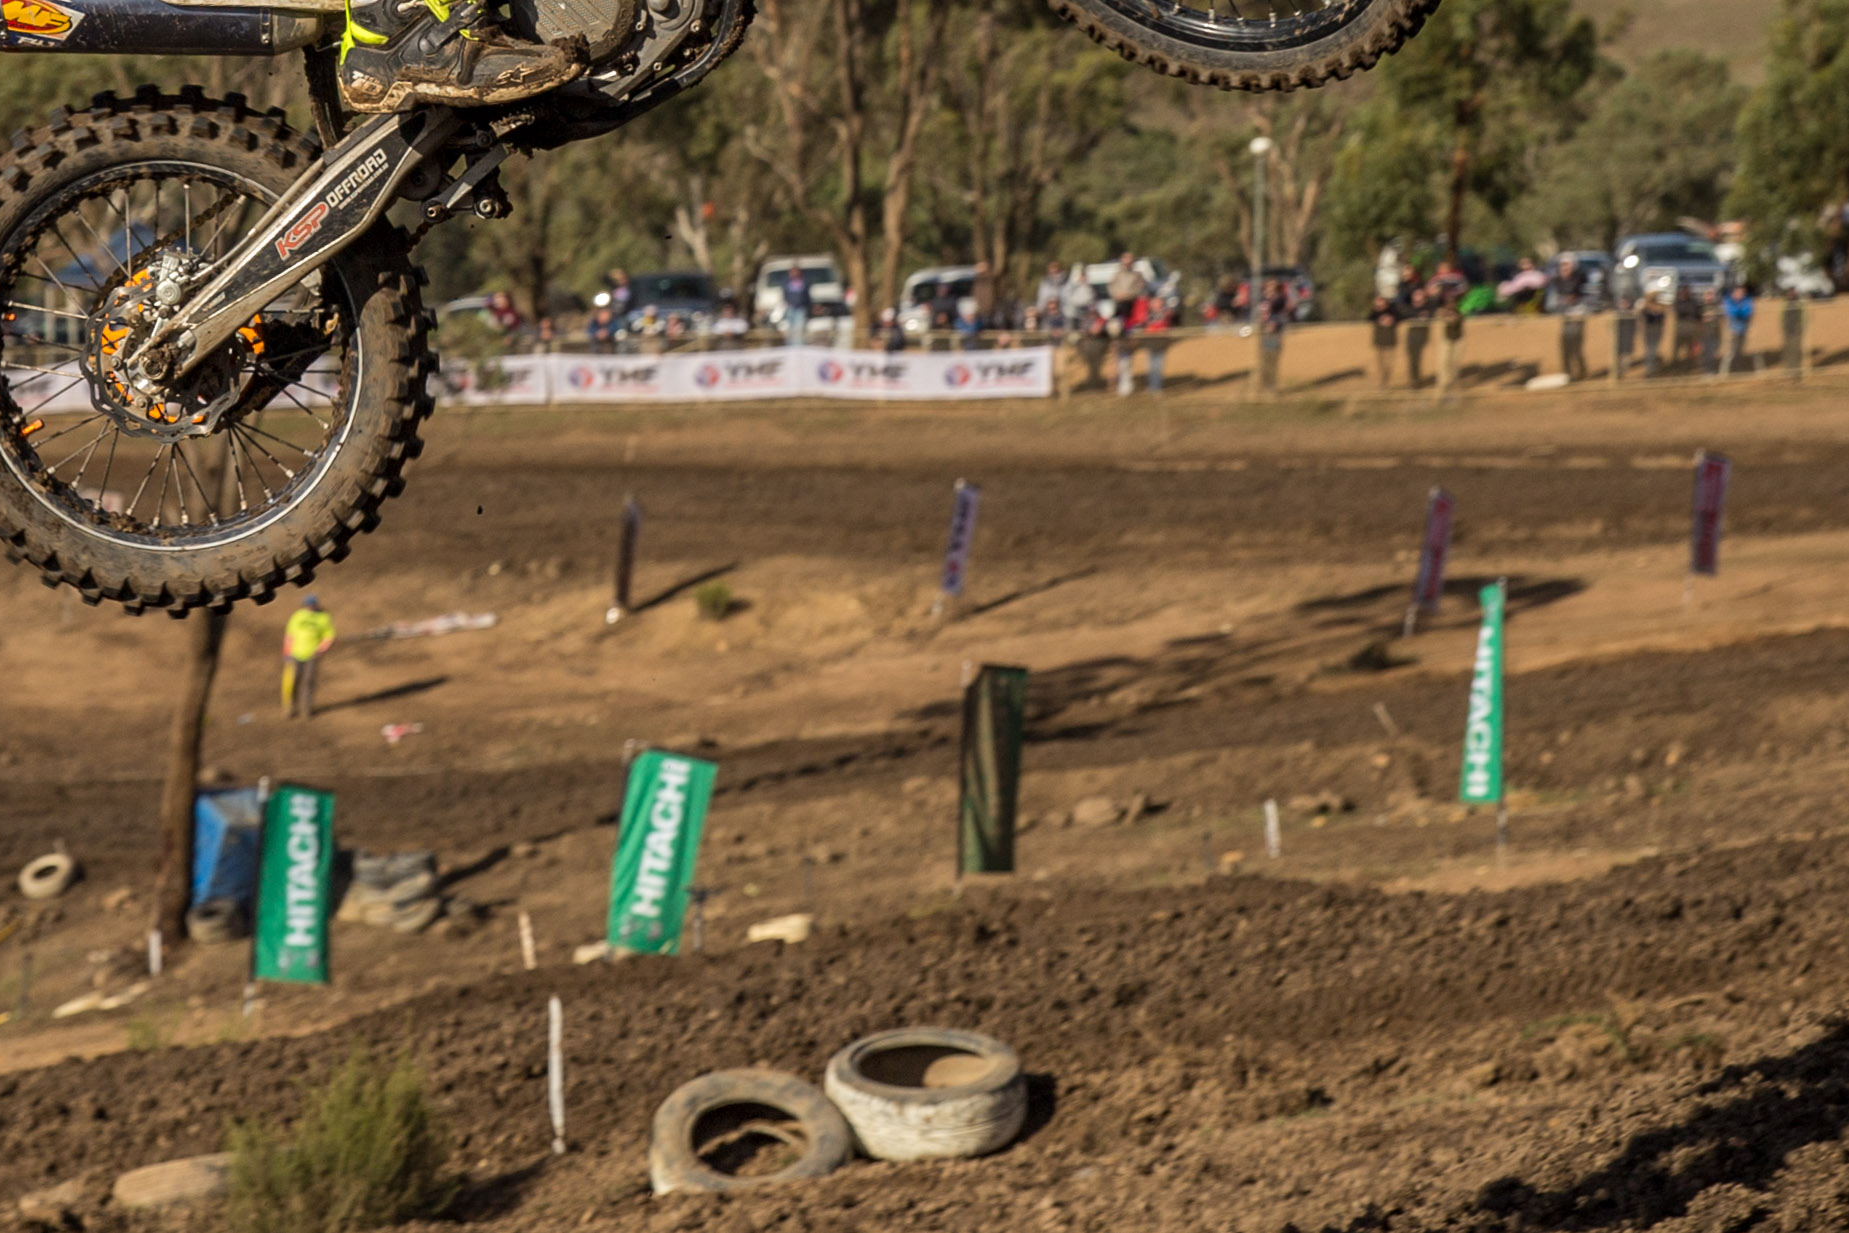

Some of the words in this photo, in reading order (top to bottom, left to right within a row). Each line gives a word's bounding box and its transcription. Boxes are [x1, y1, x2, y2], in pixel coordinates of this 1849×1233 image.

[275, 201, 330, 261] KSP
[326, 148, 388, 209] OFFROAD
[285, 793, 320, 946] HITACHI
[631, 757, 692, 918] HITACHI
